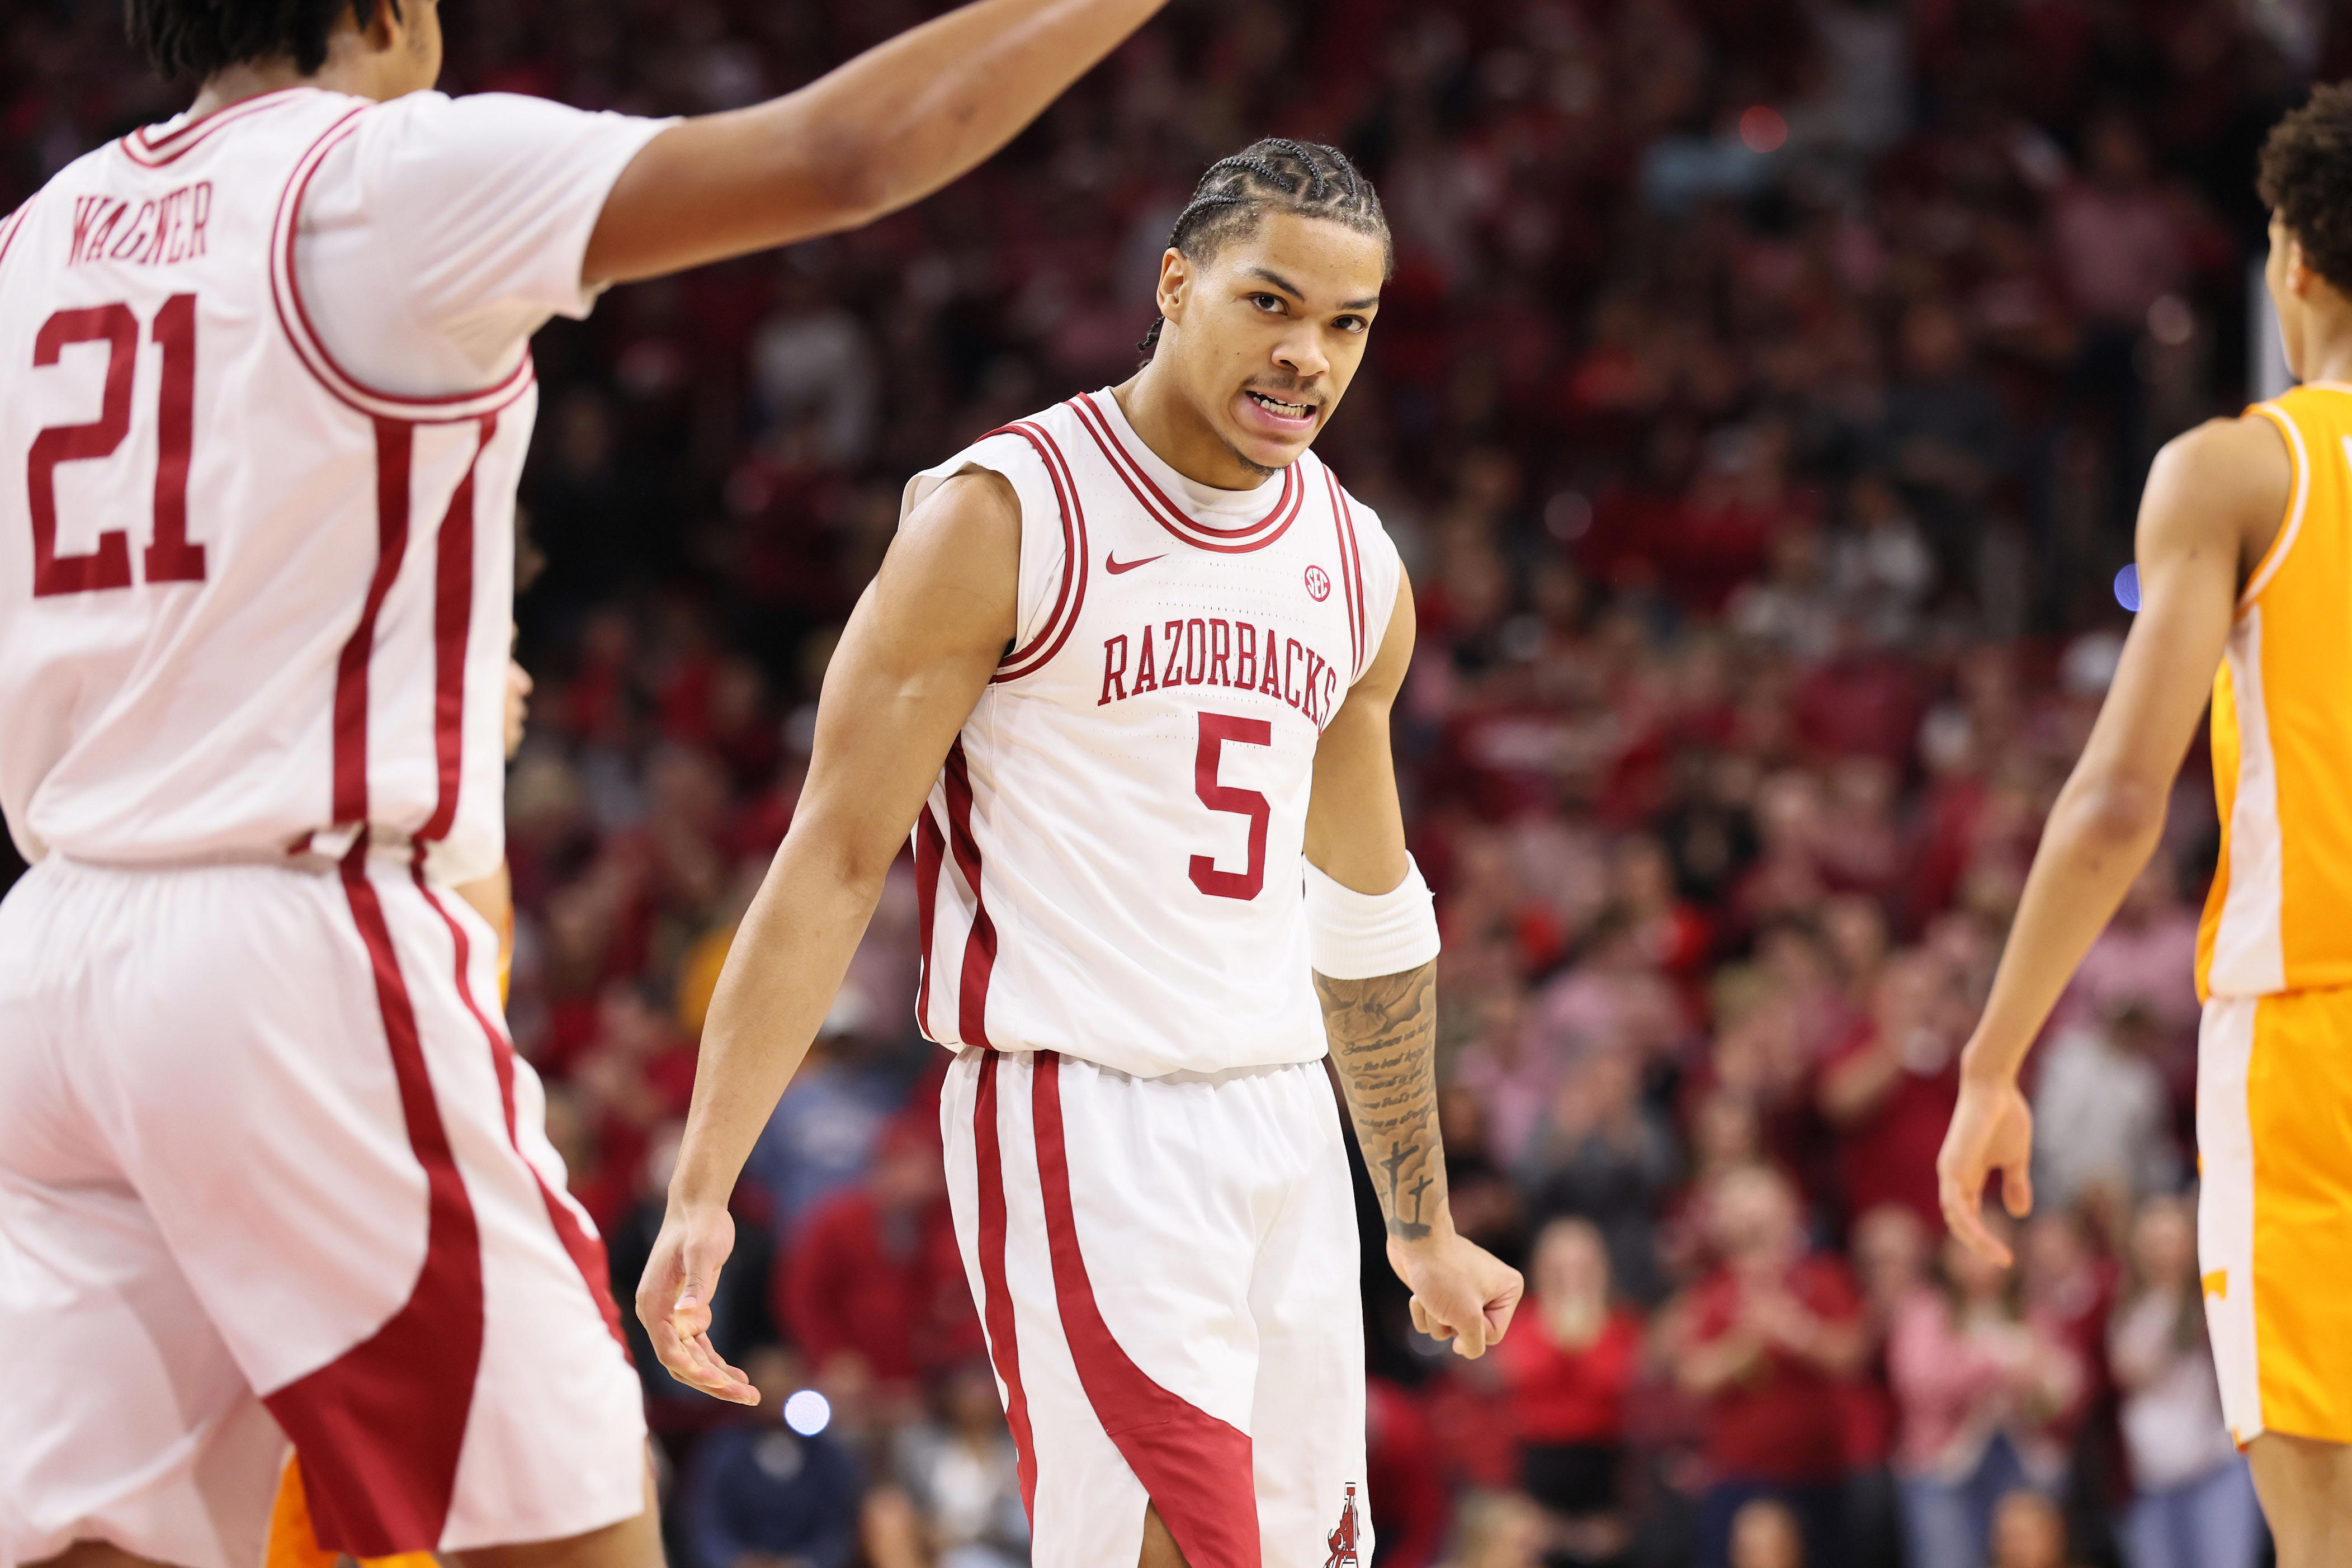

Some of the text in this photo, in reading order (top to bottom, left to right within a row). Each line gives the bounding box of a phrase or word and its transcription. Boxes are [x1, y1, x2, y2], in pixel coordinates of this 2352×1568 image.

[68, 180, 212, 266] WAGNER
[28, 292, 206, 598] 21
[1306, 567, 1329, 598] SEC
[1097, 618, 1336, 736] RAZORBACKS
[1189, 711, 1272, 901] 5
